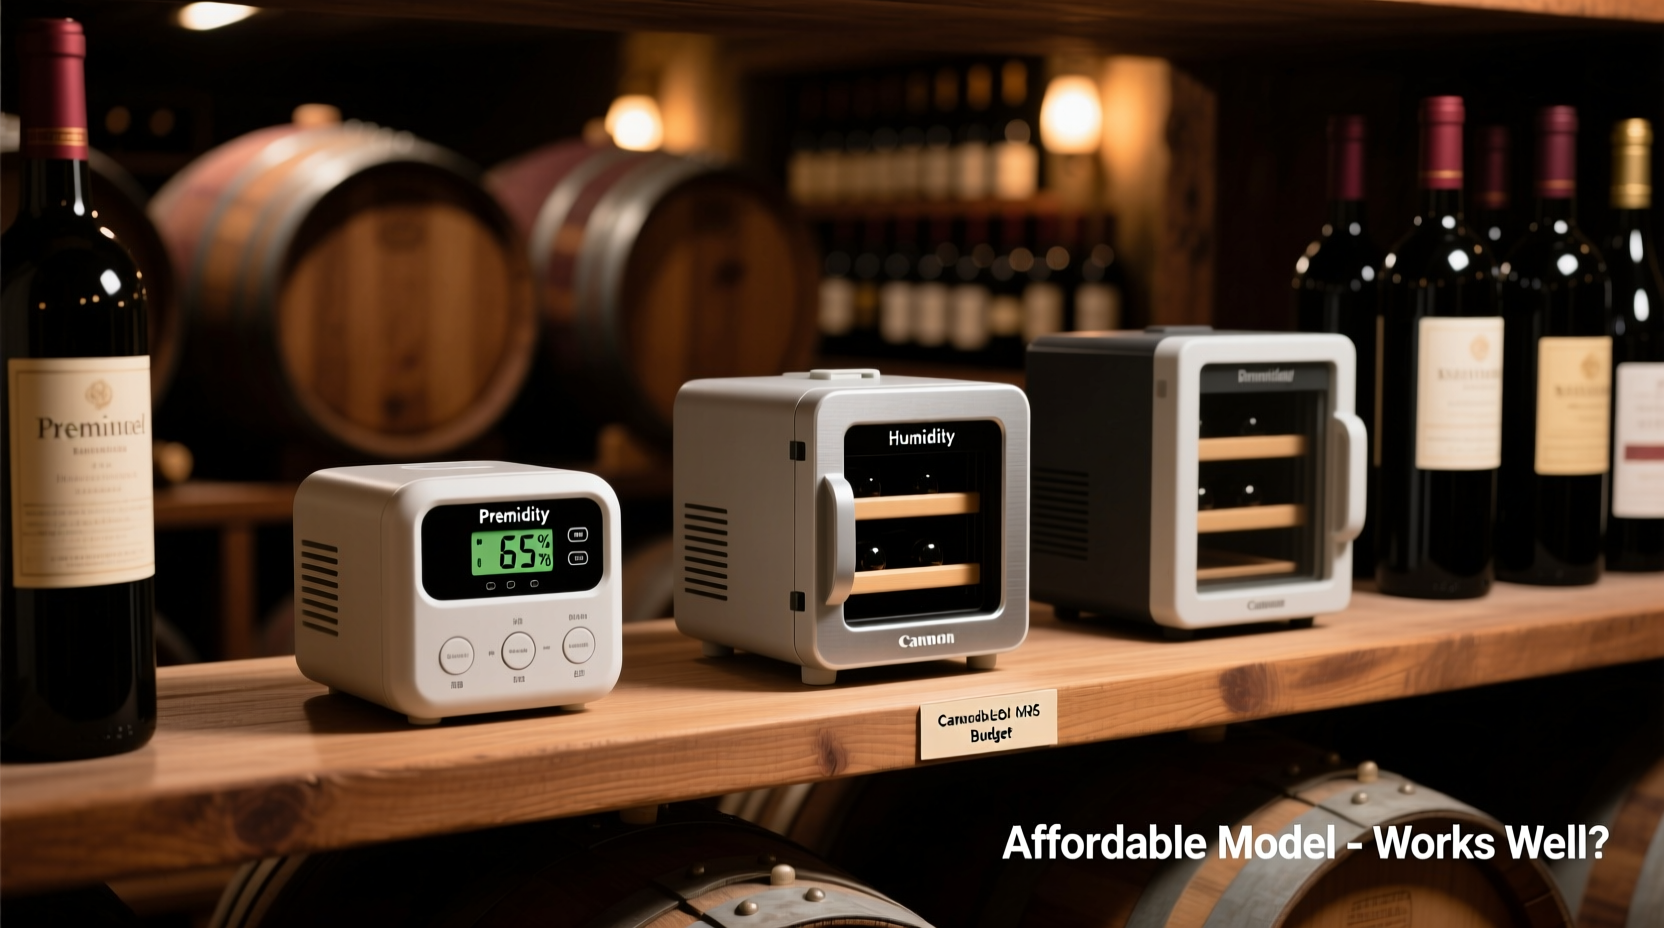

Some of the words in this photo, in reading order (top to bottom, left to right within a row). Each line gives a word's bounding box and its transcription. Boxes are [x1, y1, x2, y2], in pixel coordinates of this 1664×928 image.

[889, 427, 956, 447] Humidity
[479, 505, 551, 526] Premidity
[898, 633, 955, 649] Cannon
[970, 726, 1014, 744] Budget
